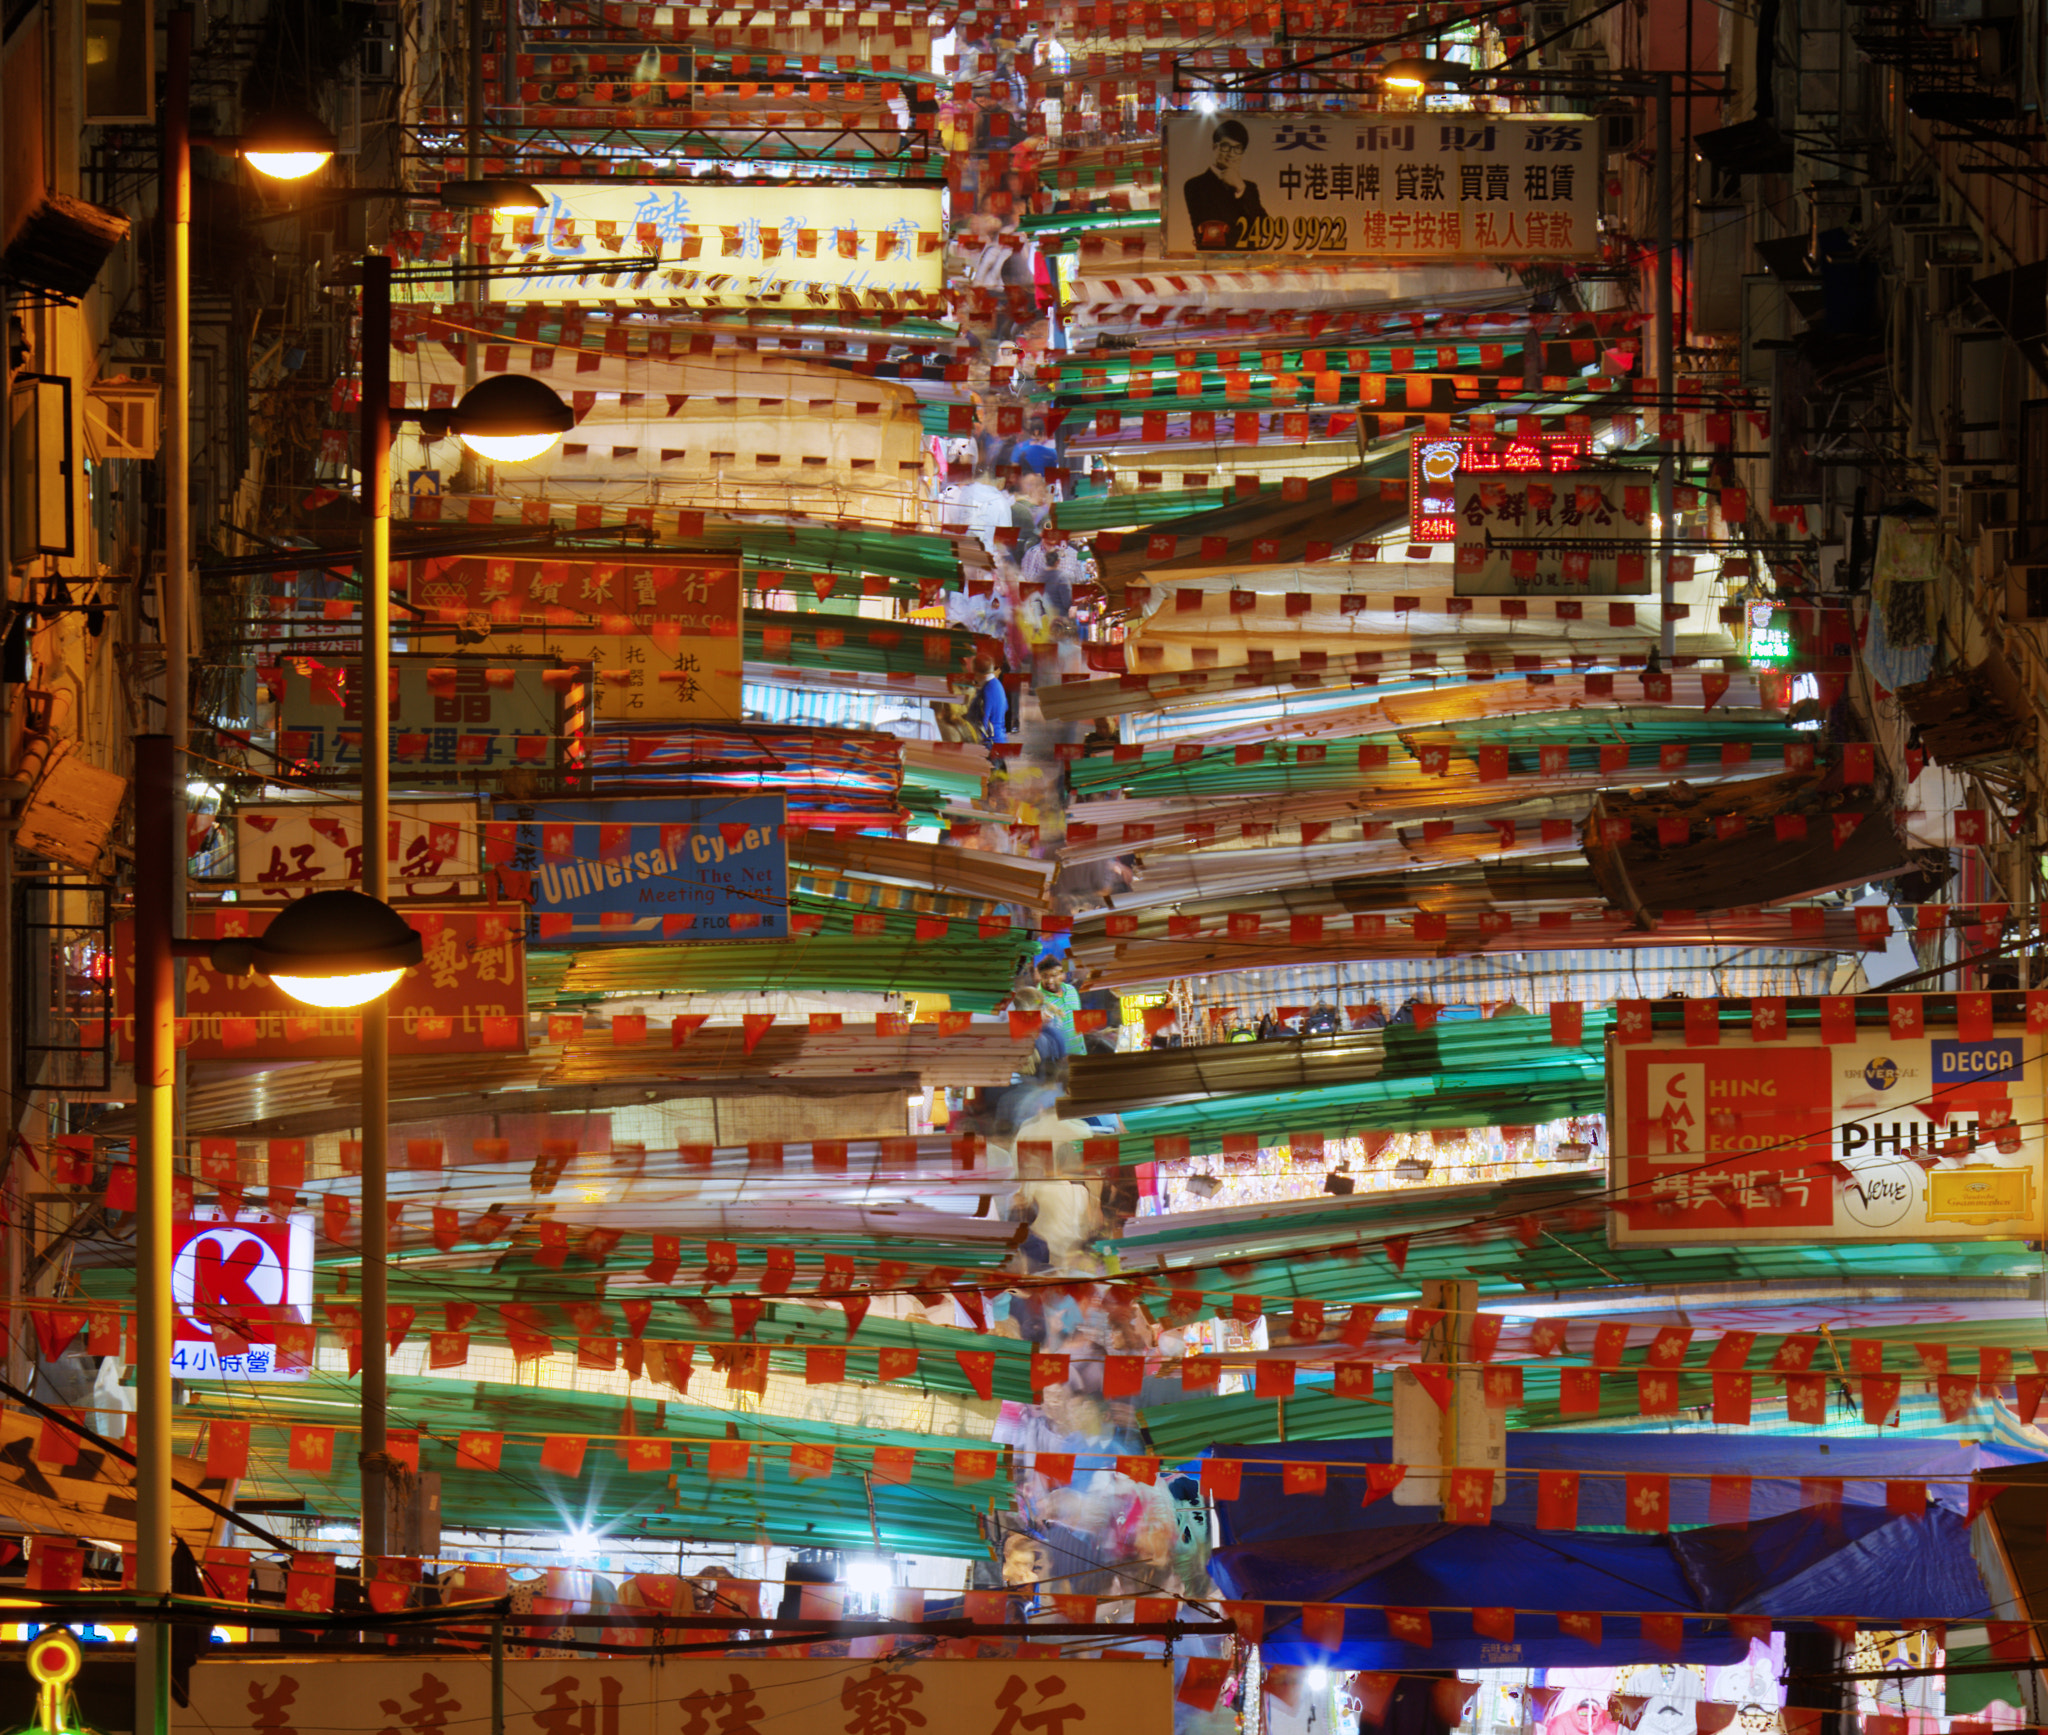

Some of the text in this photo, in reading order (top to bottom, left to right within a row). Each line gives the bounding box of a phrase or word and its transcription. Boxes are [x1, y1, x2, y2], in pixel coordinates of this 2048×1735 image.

[1272, 124, 1584, 152] 英利財務
[1278, 163, 1575, 201] 中港車牌 貸款 買賣 租賃
[1235, 216, 1348, 251] 2499 9922
[1363, 210, 1574, 249] 樓宇按揭 私人貸款
[539, 843, 679, 904] Universal
[697, 867, 773, 884] The Net
[639, 885, 773, 906] Meeting Point
[1942, 1050, 2014, 1073] DECCA
[1842, 1119, 2018, 1157] PHILI
[171, 1347, 303, 1375] 4小時營
